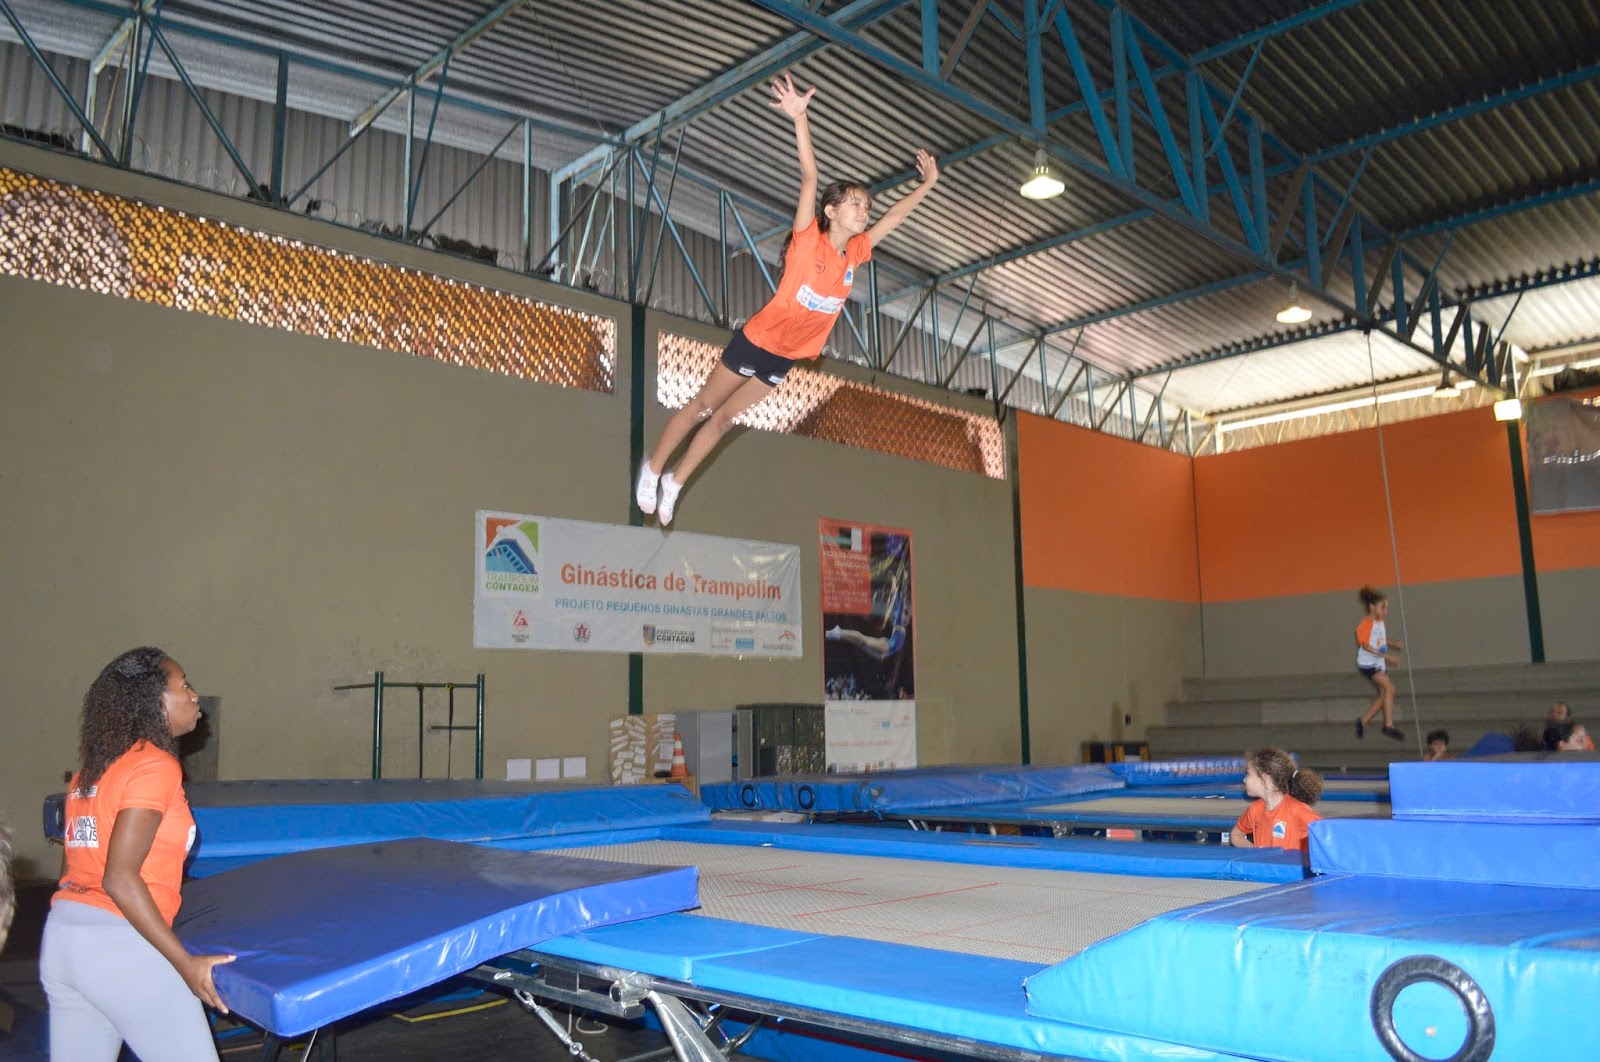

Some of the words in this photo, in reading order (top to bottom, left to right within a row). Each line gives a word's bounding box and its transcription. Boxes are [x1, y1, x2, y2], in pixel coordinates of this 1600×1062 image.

[486, 573, 539, 584] TRAMPOLIM
[561, 563, 657, 590] Ginástica
[663, 572, 686, 592] de
[693, 574, 781, 600] Trampolim
[485, 581, 539, 593] CONTAGEM
[555, 598, 604, 610] PROJETO
[606, 600, 661, 613] PEQUENOS
[663, 604, 709, 617] GINASTAS
[711, 607, 753, 619] GRANDES
[657, 635, 695, 643] CONTAGEM
